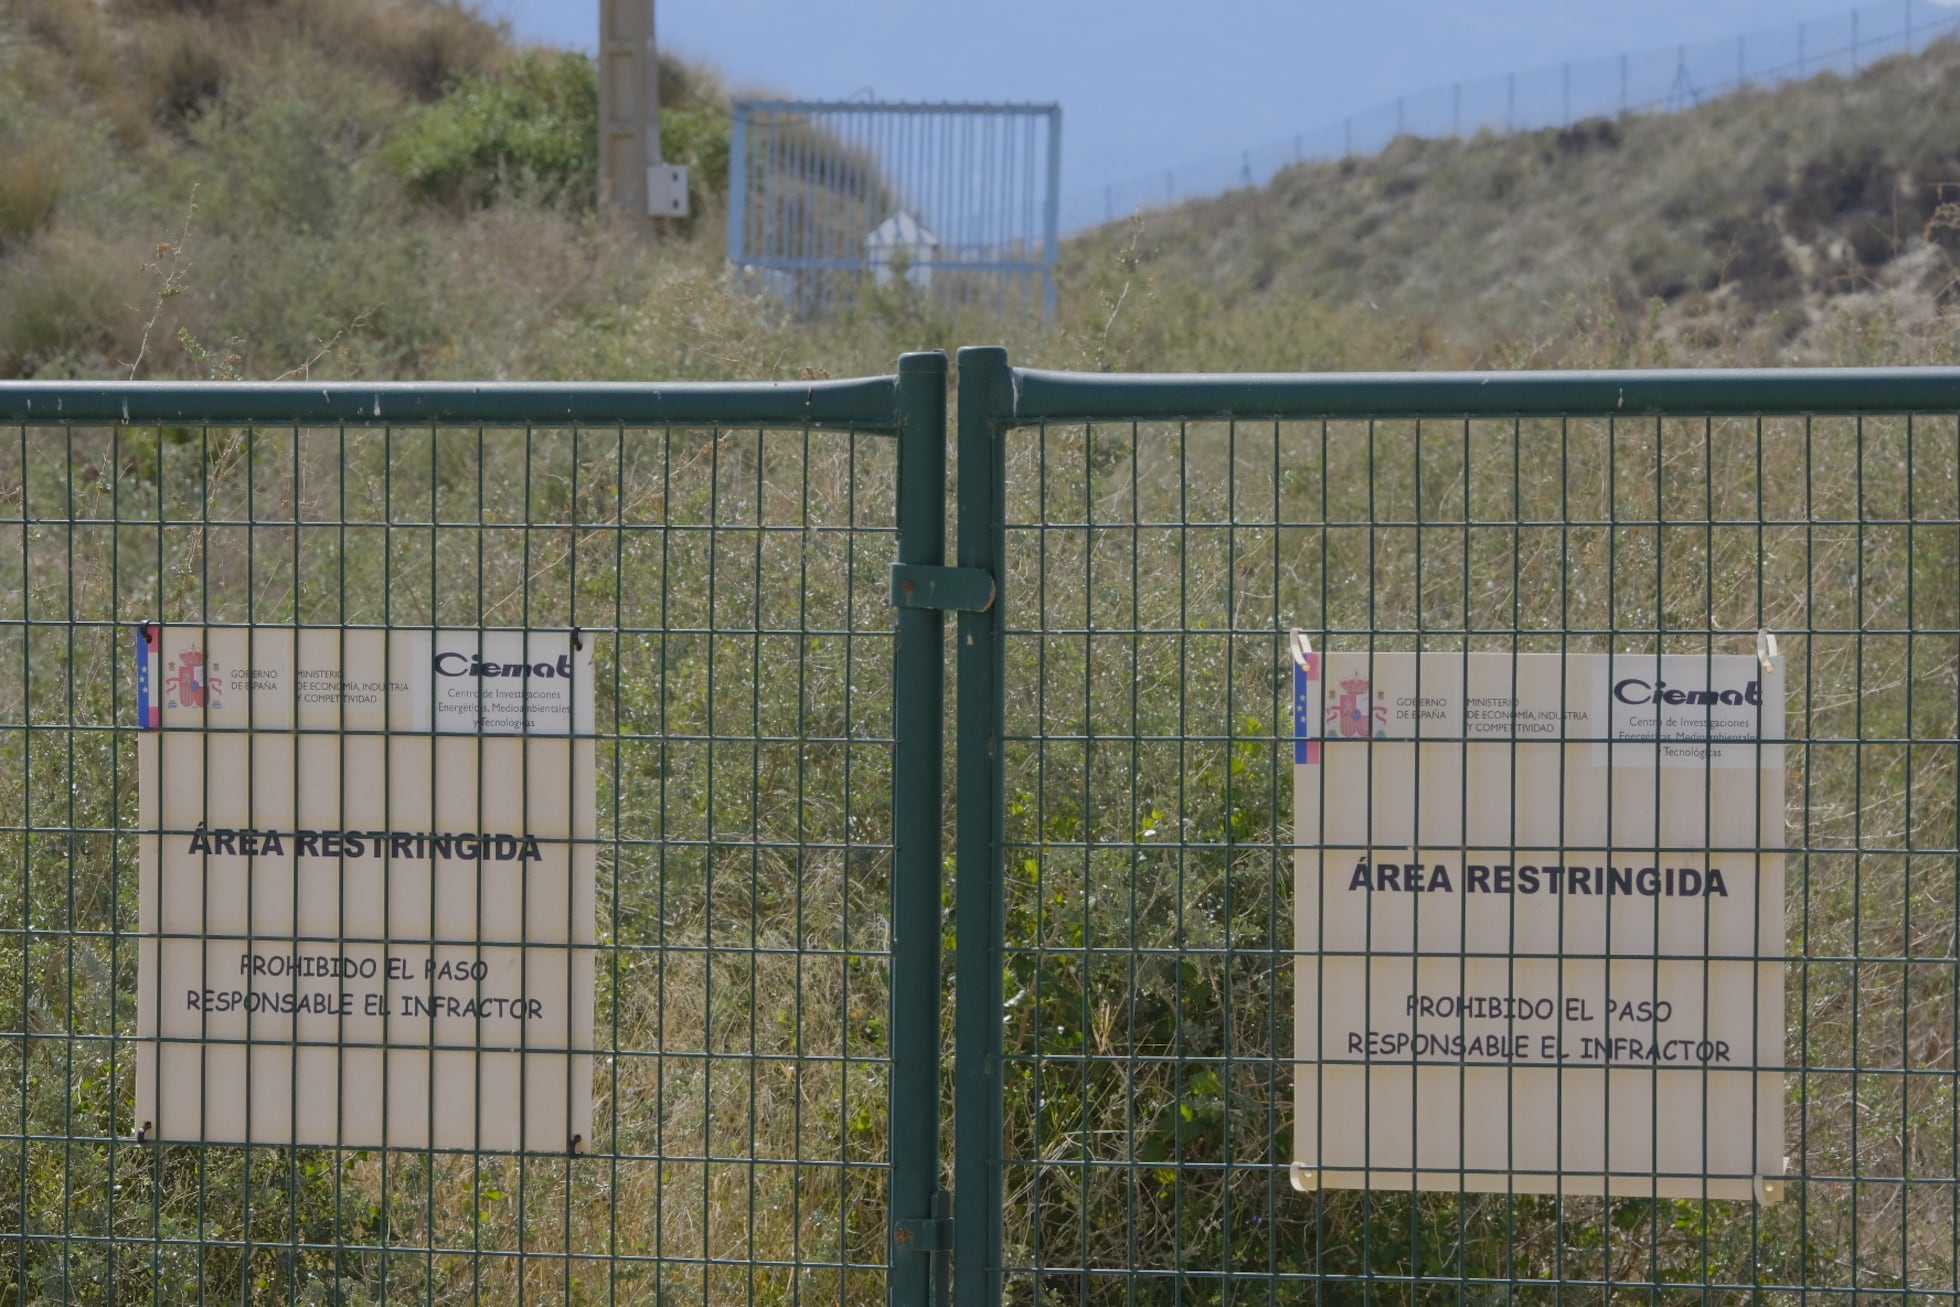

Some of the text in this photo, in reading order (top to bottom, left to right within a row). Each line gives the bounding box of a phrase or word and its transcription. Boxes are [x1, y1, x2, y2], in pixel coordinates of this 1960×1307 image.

[434, 652, 572, 679] Ciemat
[231, 669, 278, 679] GOBERNO
[231, 680, 278, 691] DE EPAÑA
[363, 683, 408, 692] INDUTRIA
[1614, 678, 1763, 706] Ciemat
[304, 694, 377, 704] COMPETTIVIDAD
[447, 688, 561, 701] Centro de Investaciones
[1397, 698, 1447, 708] GOBERNO
[1397, 709, 1447, 720] DE EPAÑA
[1467, 711, 1480, 720] DE
[481, 716, 535, 729] Tecnológias
[1475, 723, 1554, 733] COMPETTIVIDAD
[1666, 716, 1677, 727] de
[1680, 716, 1750, 729] Investgaciones
[1664, 746, 1722, 760] Tecnológas
[188, 822, 542, 861] ÁREA RESTRINGIDA
[1348, 856, 1728, 897] ÁREA RESTRINGIDA
[240, 955, 488, 981] PROHIBIDO EL PASO
[187, 990, 543, 1019] RESPONSABLE EL INFRACTOR
[1406, 995, 1672, 1022] PROHIBIDO EL PASO
[1348, 1032, 1529, 1058] RESPONSABLE
[1580, 1037, 1730, 1062] INFRACTOR
